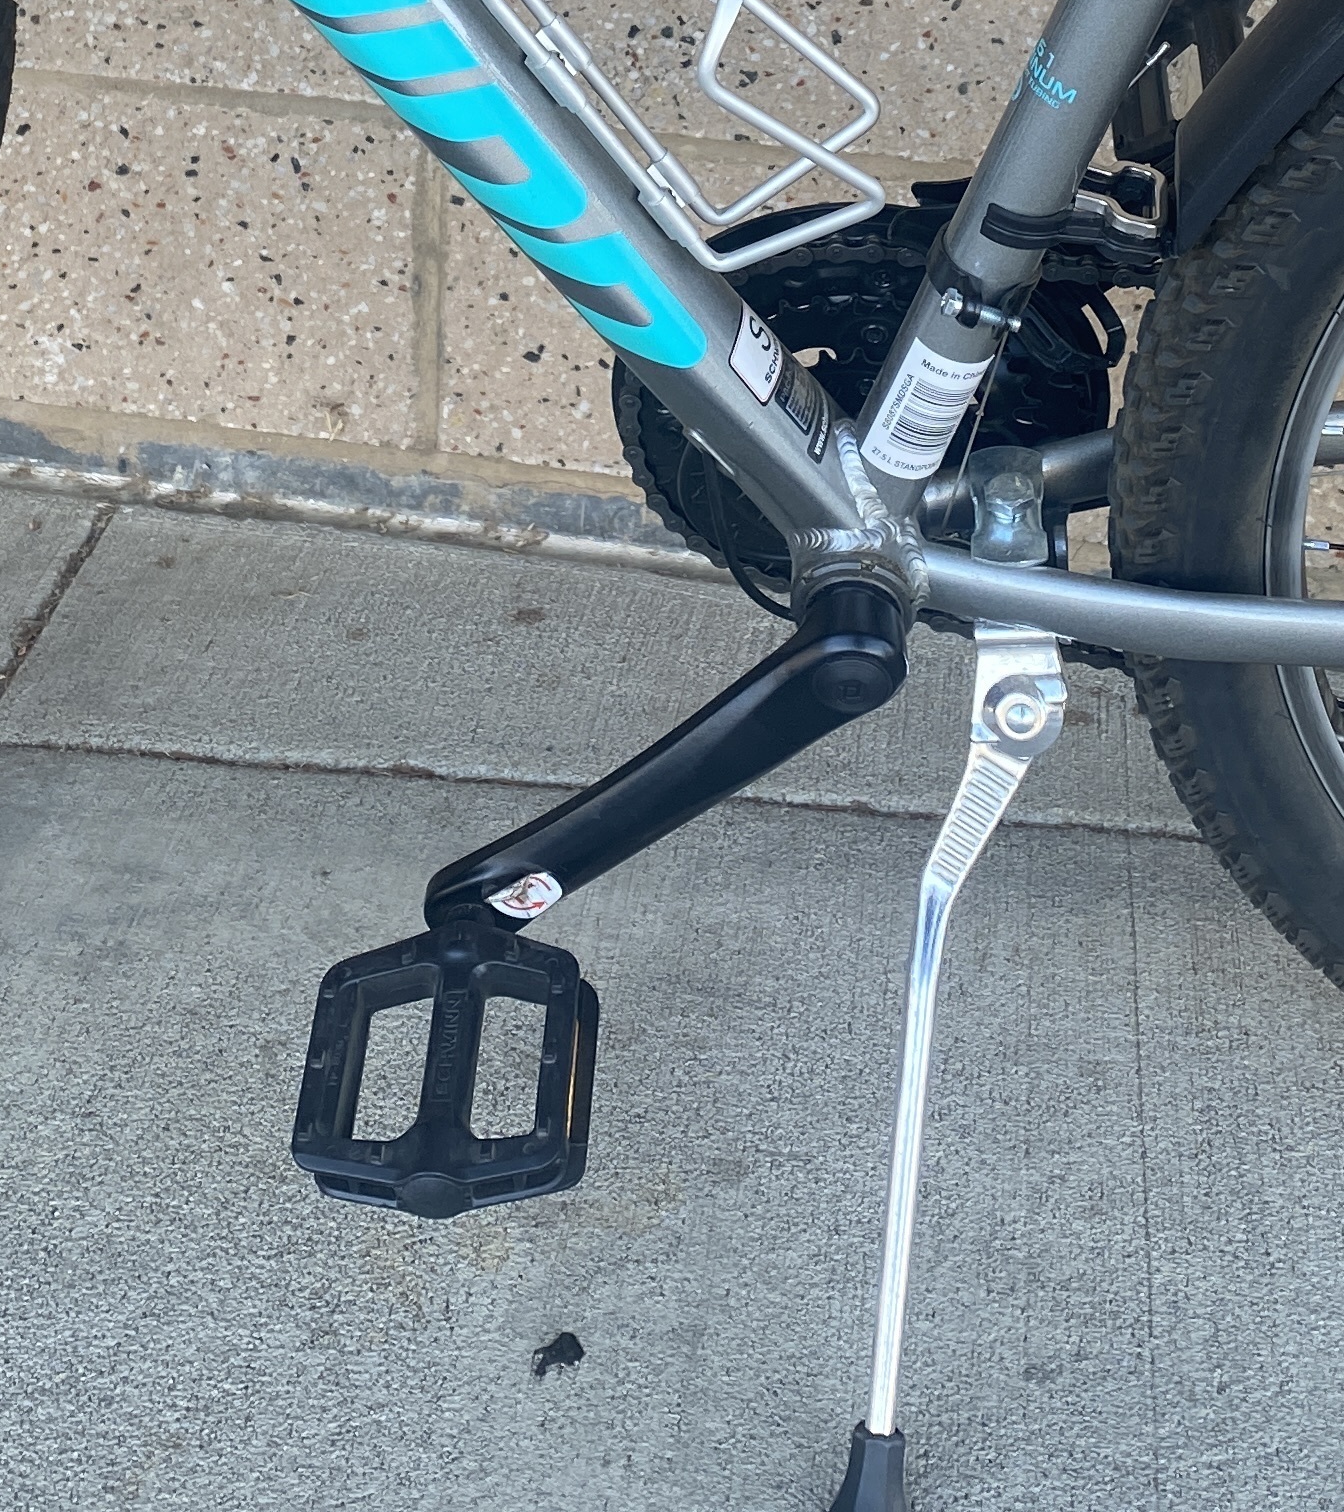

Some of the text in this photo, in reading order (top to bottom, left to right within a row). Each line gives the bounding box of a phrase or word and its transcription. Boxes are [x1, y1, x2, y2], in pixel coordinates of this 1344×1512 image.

[920, 358, 949, 378] Made
[950, 371, 961, 381] in
[435, 998, 462, 1096] SCHWINN
